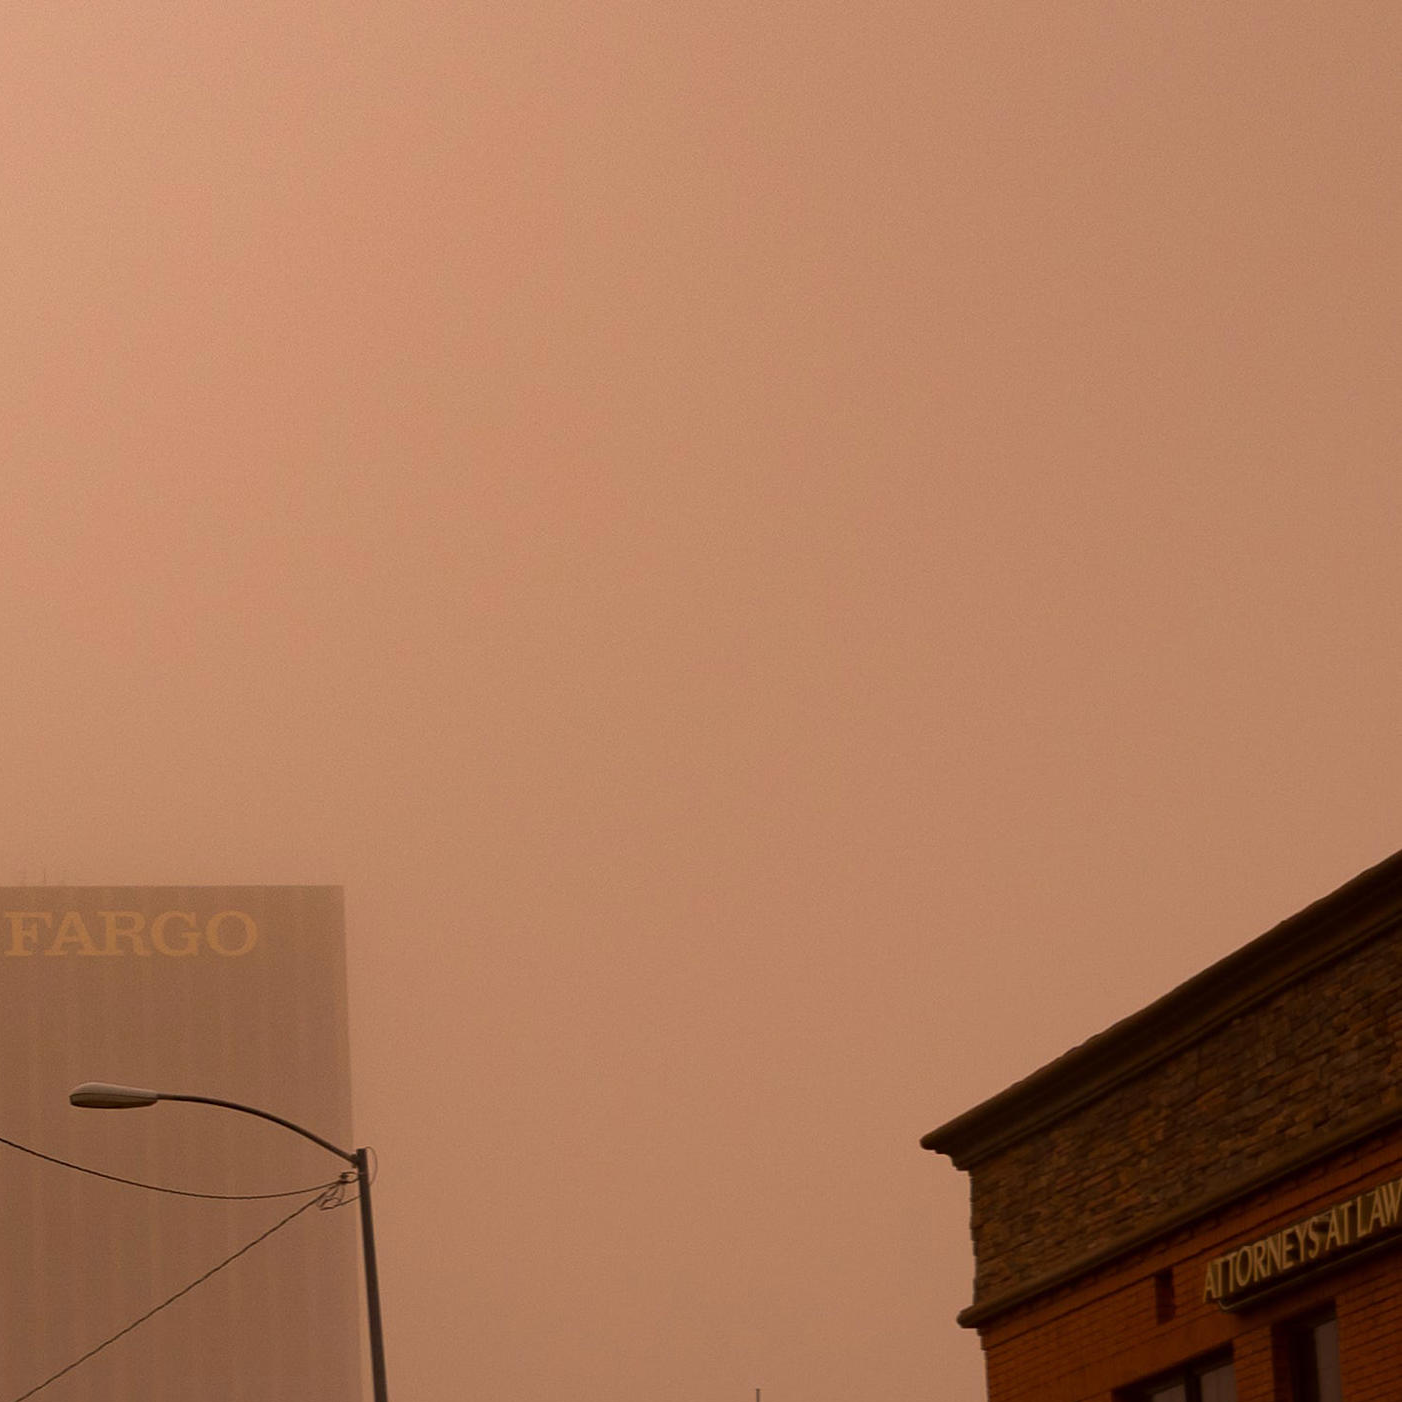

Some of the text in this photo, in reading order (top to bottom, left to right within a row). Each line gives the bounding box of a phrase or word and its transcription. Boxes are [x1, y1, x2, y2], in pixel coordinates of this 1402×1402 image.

[4, 910, 259, 960] FARGO
[1203, 1177, 1402, 1303] ATTORNEYS AT LAW
